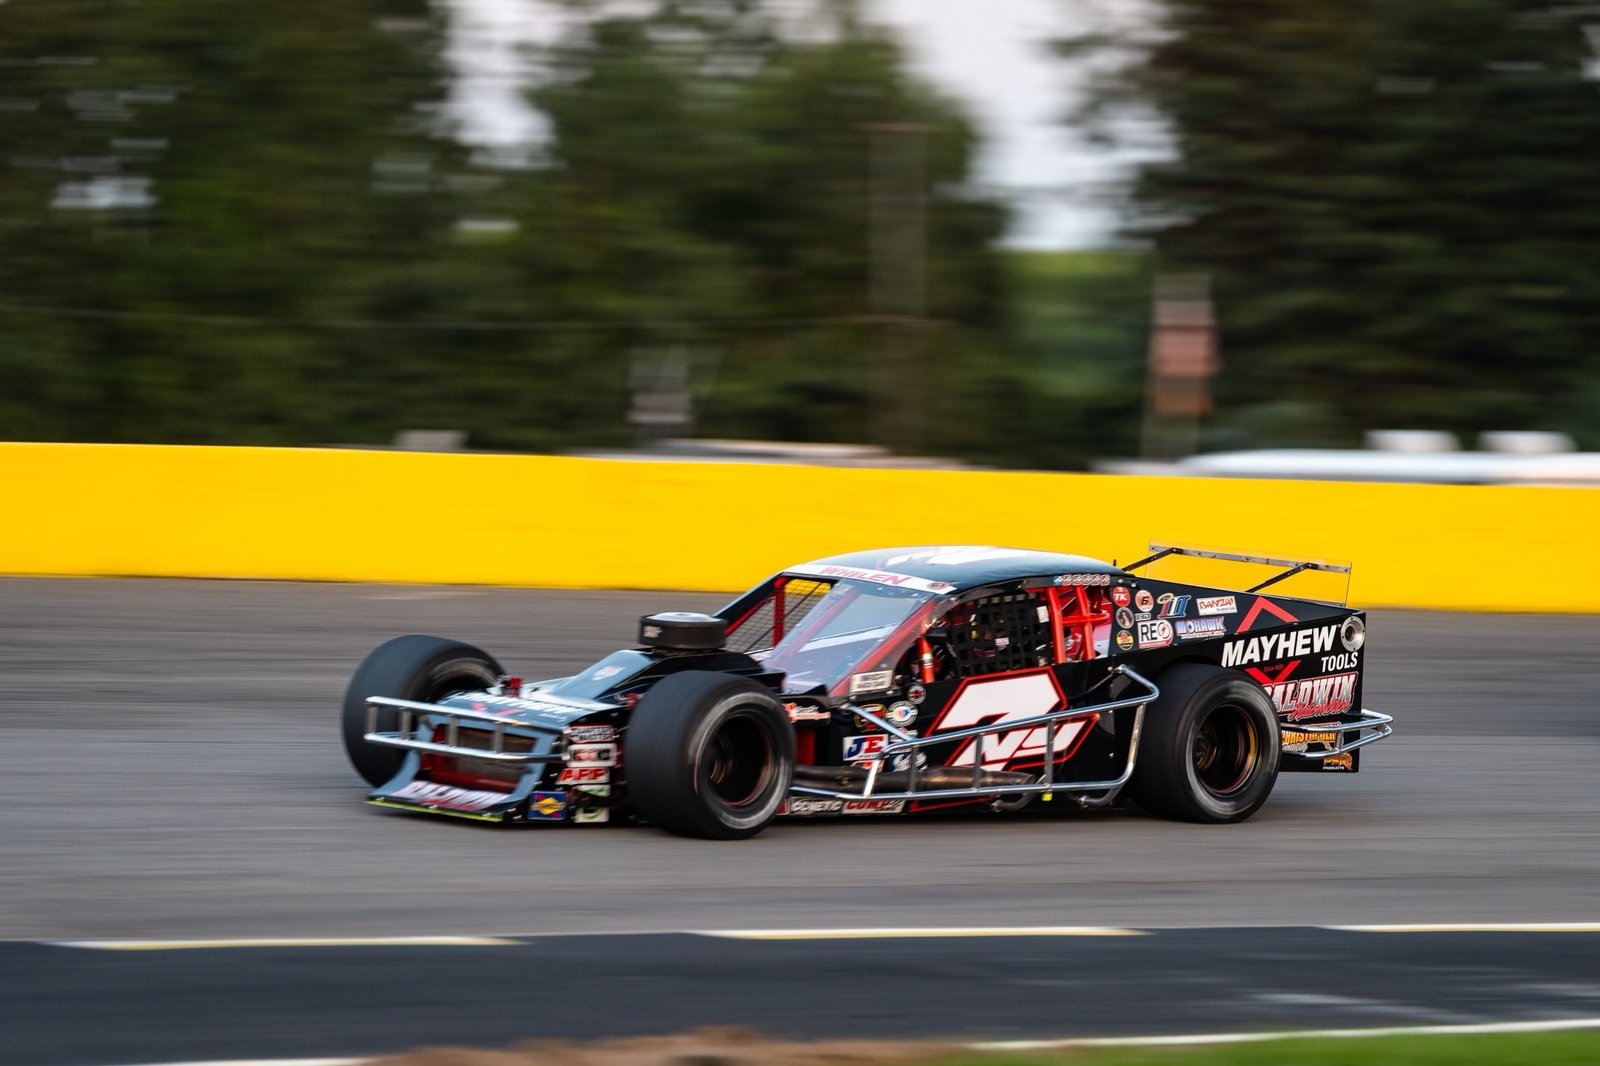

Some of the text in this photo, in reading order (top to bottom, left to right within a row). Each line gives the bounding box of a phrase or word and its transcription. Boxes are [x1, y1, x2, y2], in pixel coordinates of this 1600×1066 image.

[1113, 593, 1128, 601] TK
[1175, 617, 1227, 635] MOHAWK
[1221, 624, 1337, 668] MAYHEW
[1321, 651, 1359, 673] TOOLS
[847, 735, 885, 759] JE
